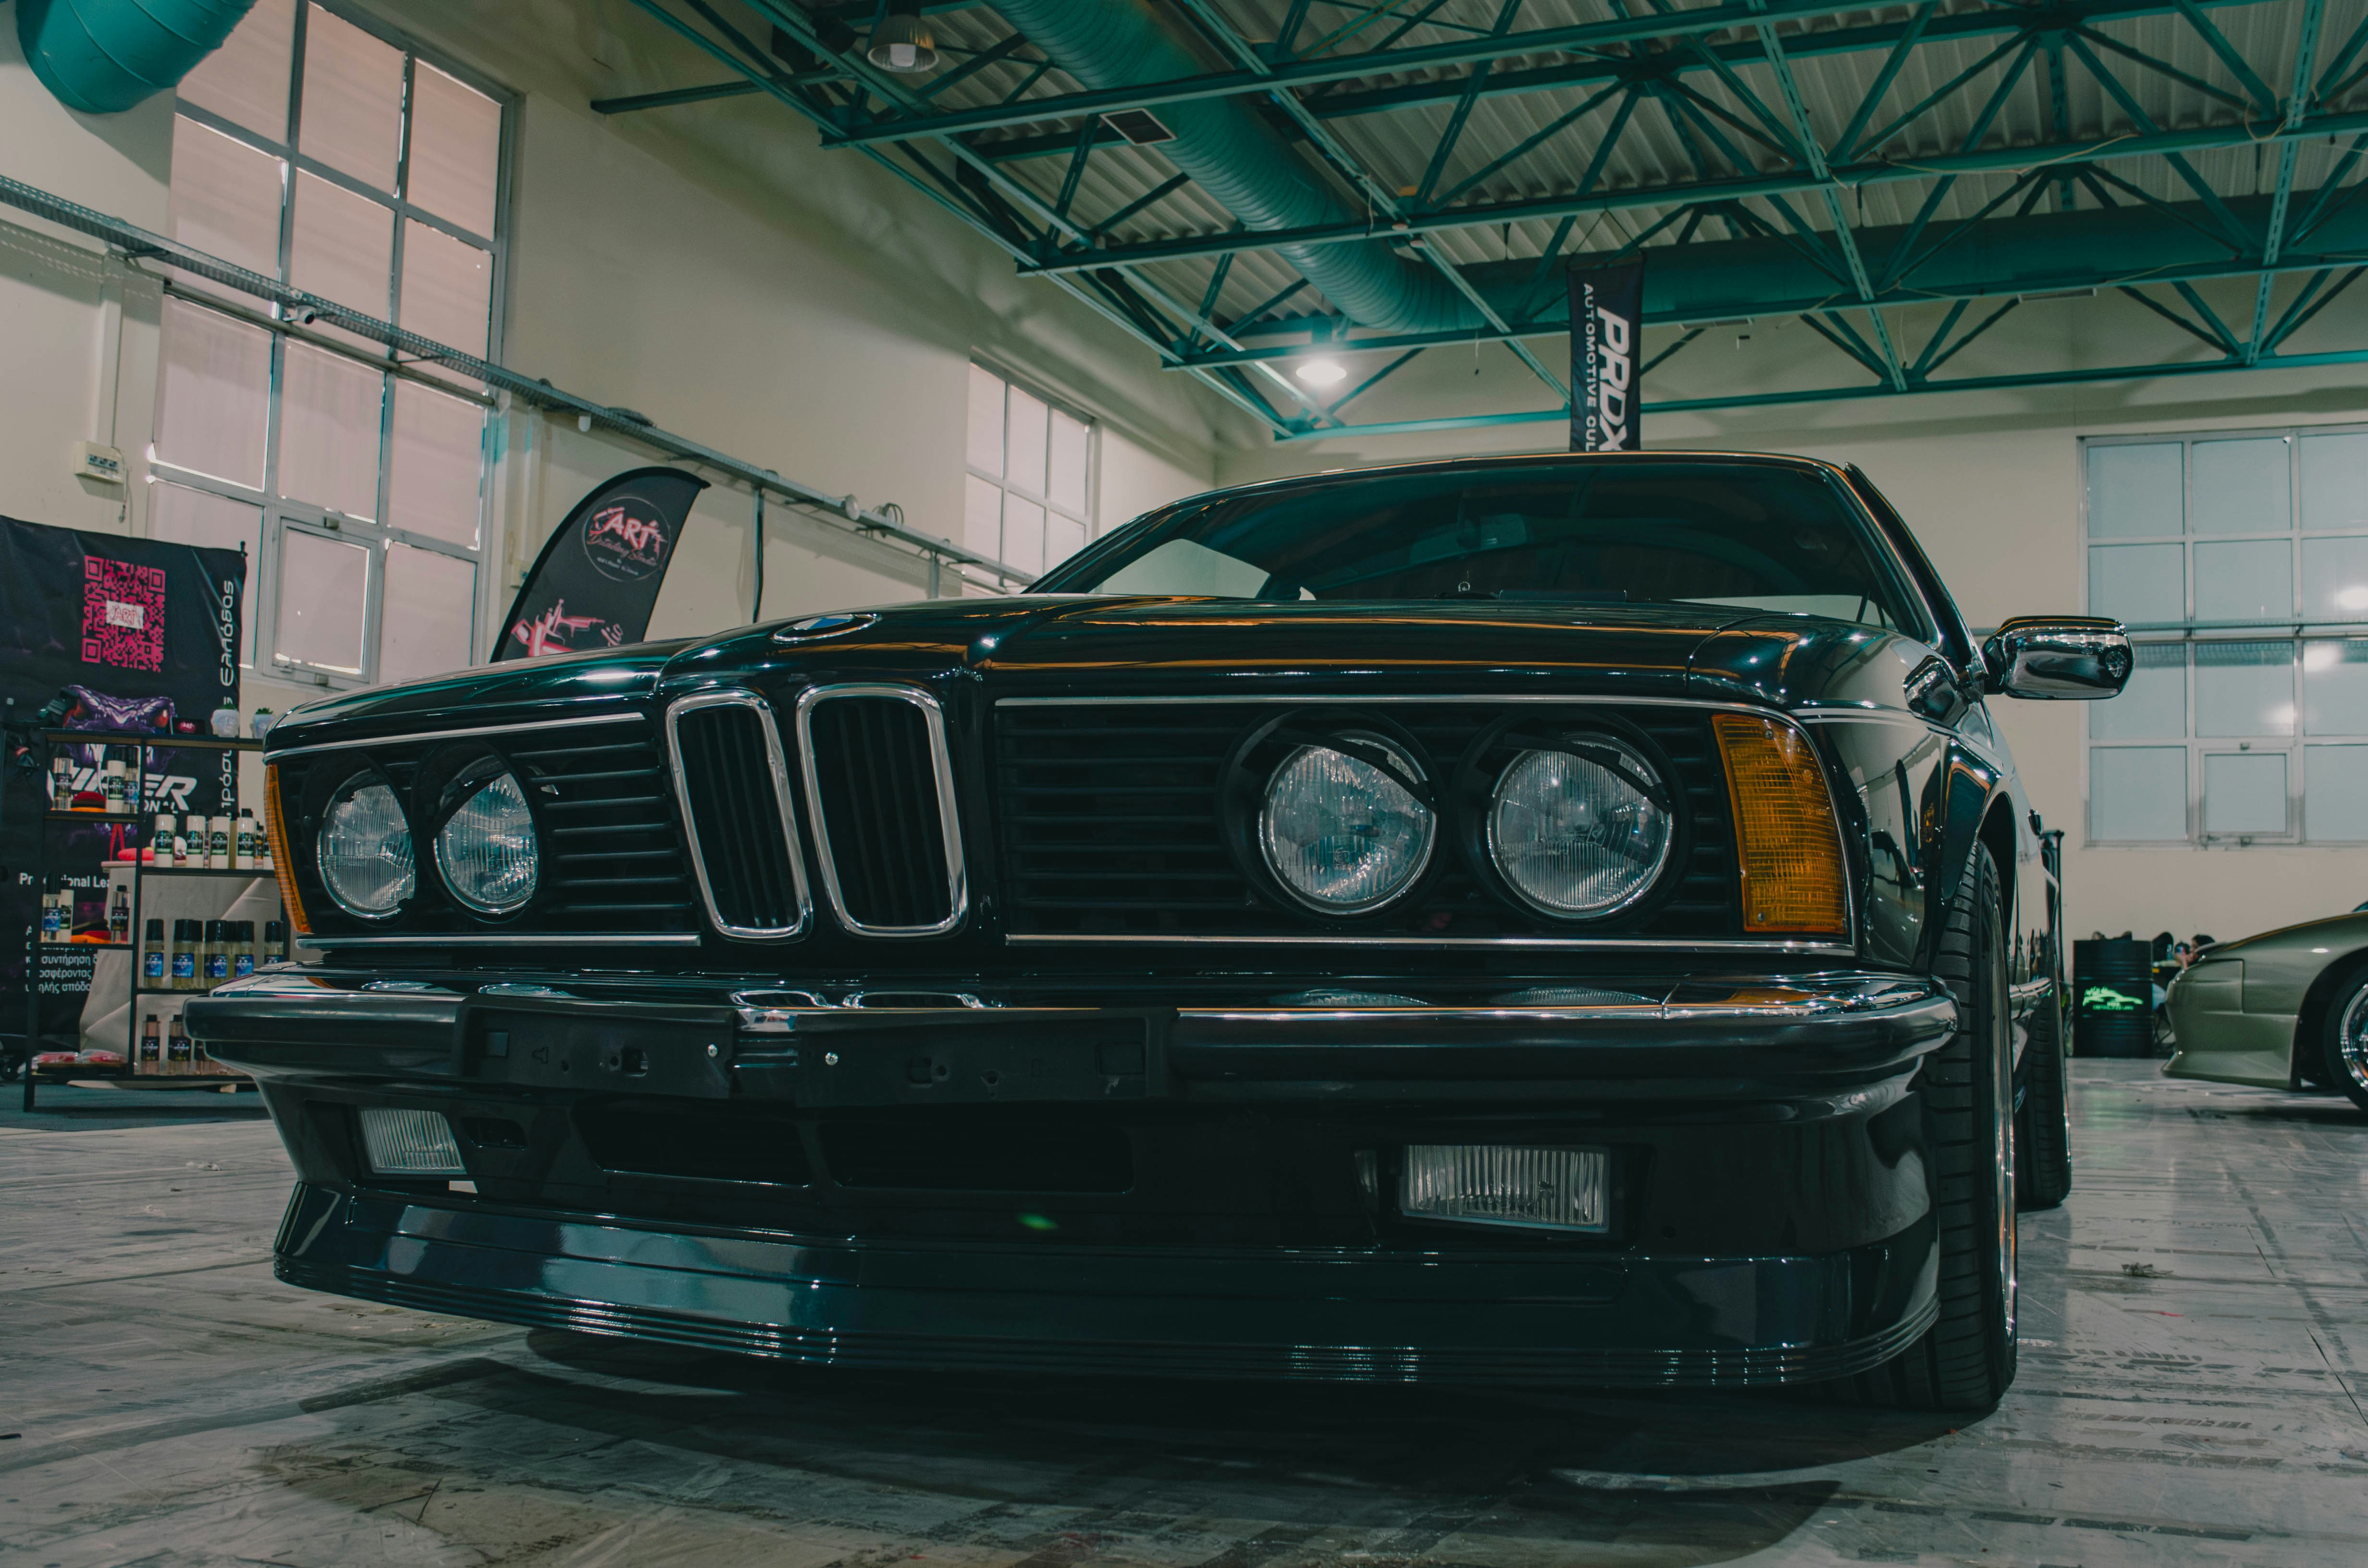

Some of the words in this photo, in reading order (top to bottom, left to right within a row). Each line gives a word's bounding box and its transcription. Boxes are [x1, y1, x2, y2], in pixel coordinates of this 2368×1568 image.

[1583, 283, 1598, 408] AUTOMOTIVE
[1585, 419, 1597, 451] CUL
[41, 954, 91, 966] συντήρηση
